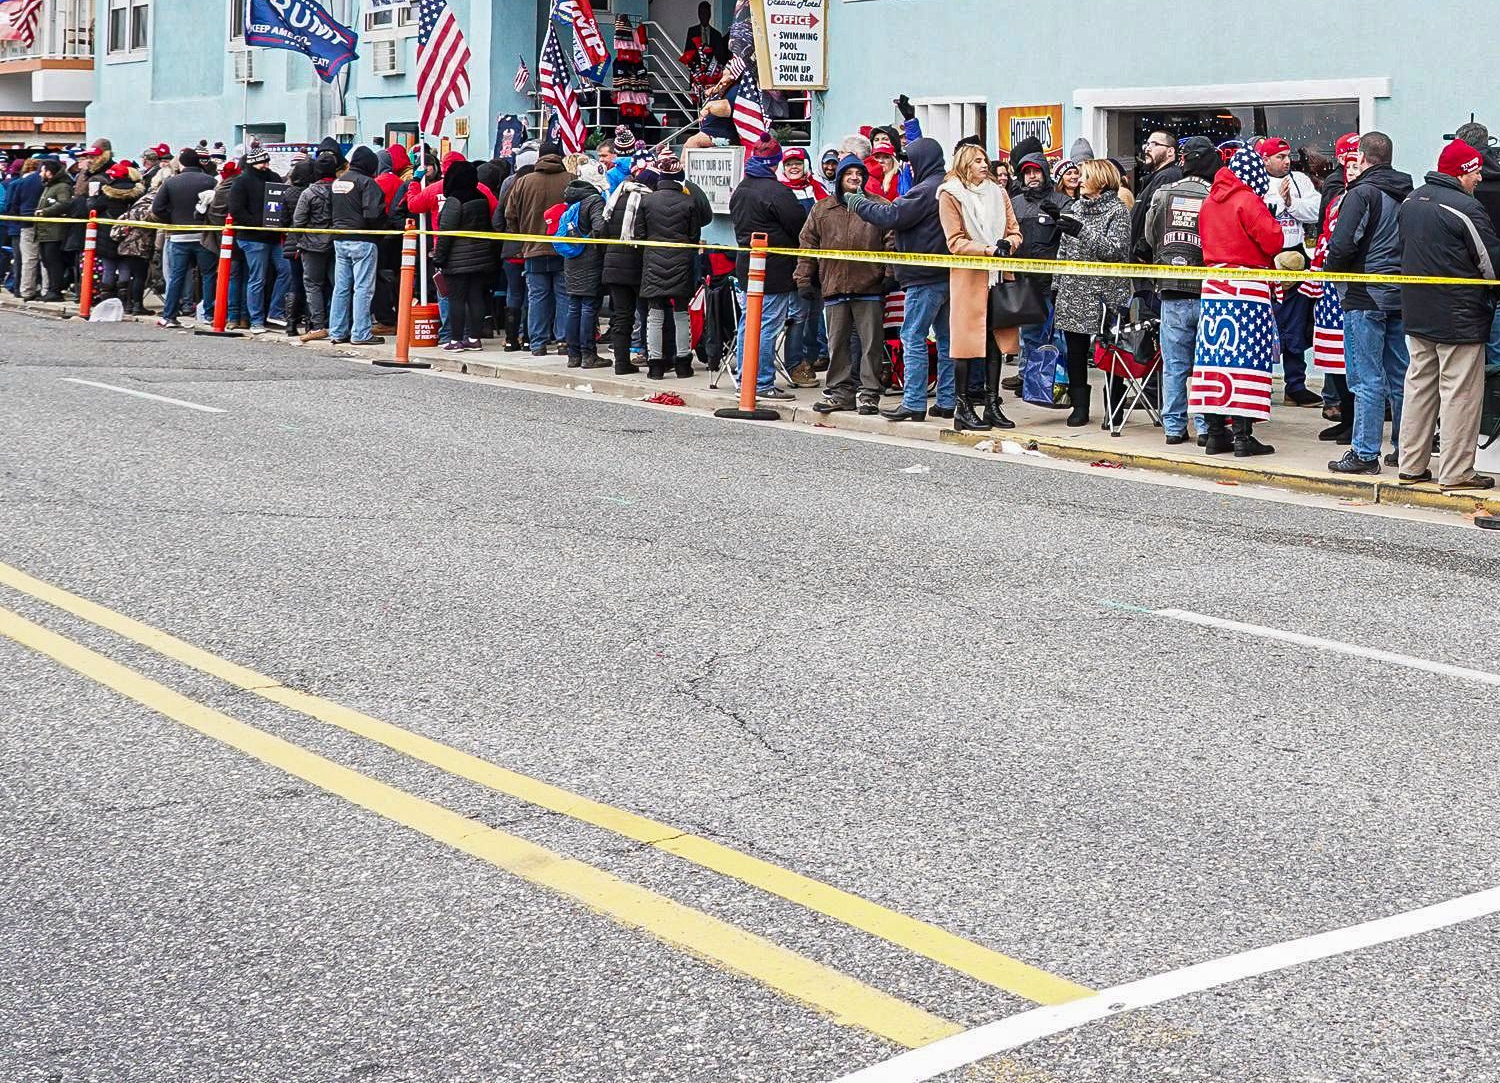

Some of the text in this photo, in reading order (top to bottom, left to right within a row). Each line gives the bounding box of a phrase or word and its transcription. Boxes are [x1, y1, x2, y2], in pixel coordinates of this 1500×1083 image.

[774, 14, 811, 25] OFFICE
[252, 24, 271, 35] KEEP
[779, 31, 818, 41] SWIMMING
[780, 42, 798, 51] POOL
[779, 53, 807, 61] JACUZZI
[779, 65, 811, 73] SWIM UP
[780, 74, 814, 82] POOL BAR
[1010, 116, 1052, 149] HOTHANDS
[690, 160, 704, 171] VISIT
[706, 160, 716, 171] OUR
